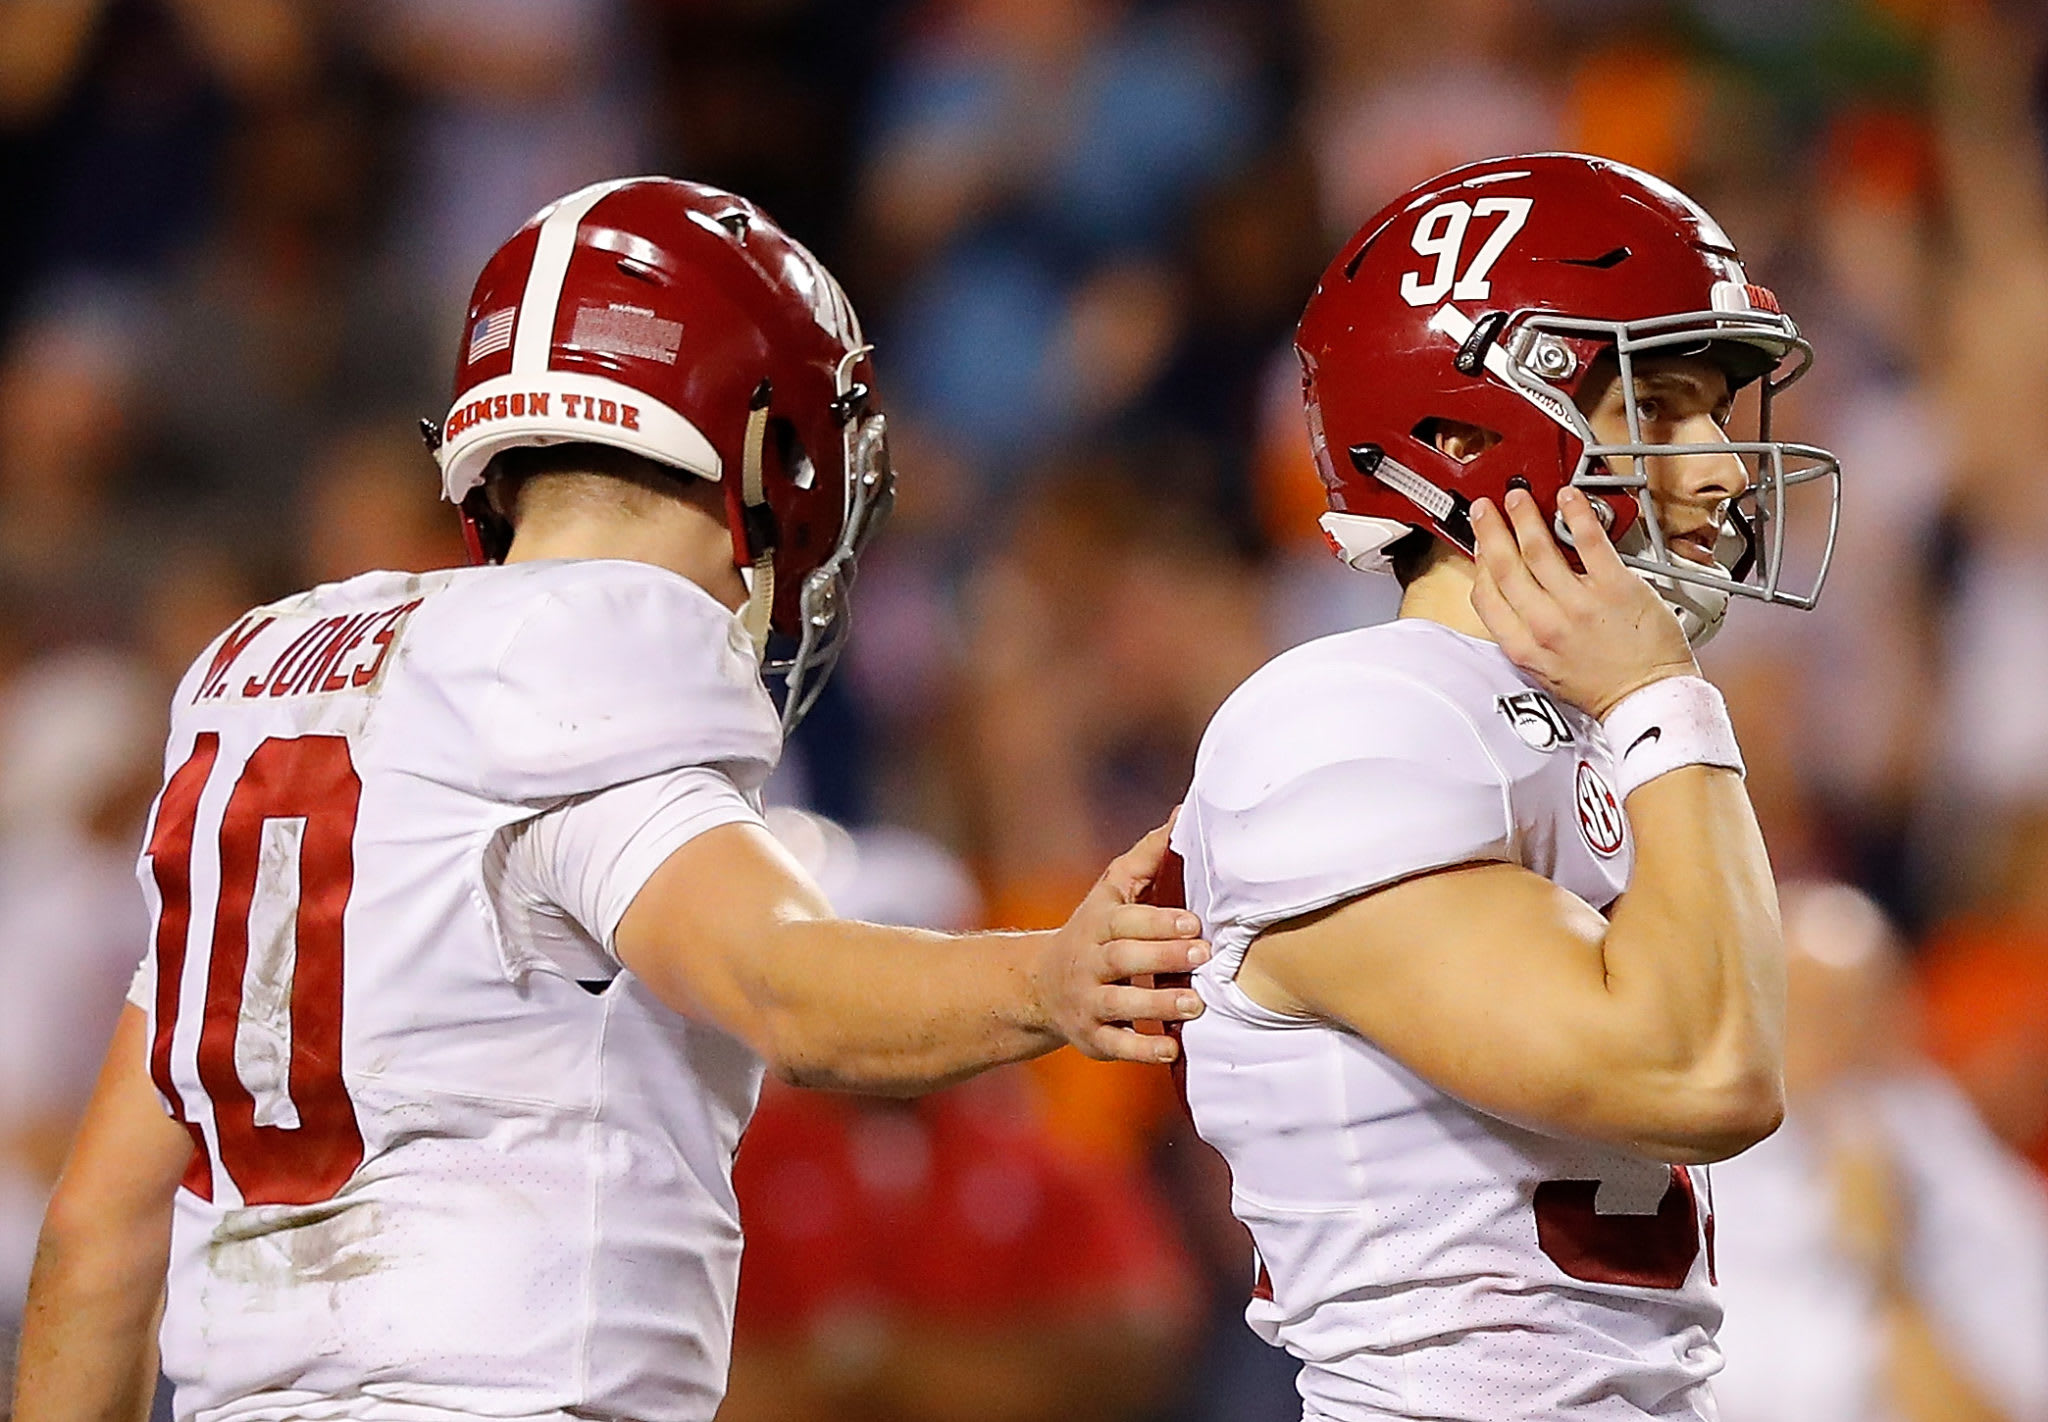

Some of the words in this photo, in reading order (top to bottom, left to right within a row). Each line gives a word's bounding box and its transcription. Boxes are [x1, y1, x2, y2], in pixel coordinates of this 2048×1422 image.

[1400, 197, 1534, 307] 97
[561, 393, 640, 431] TIDE
[242, 597, 425, 698] JONES
[144, 731, 365, 1206] 10
